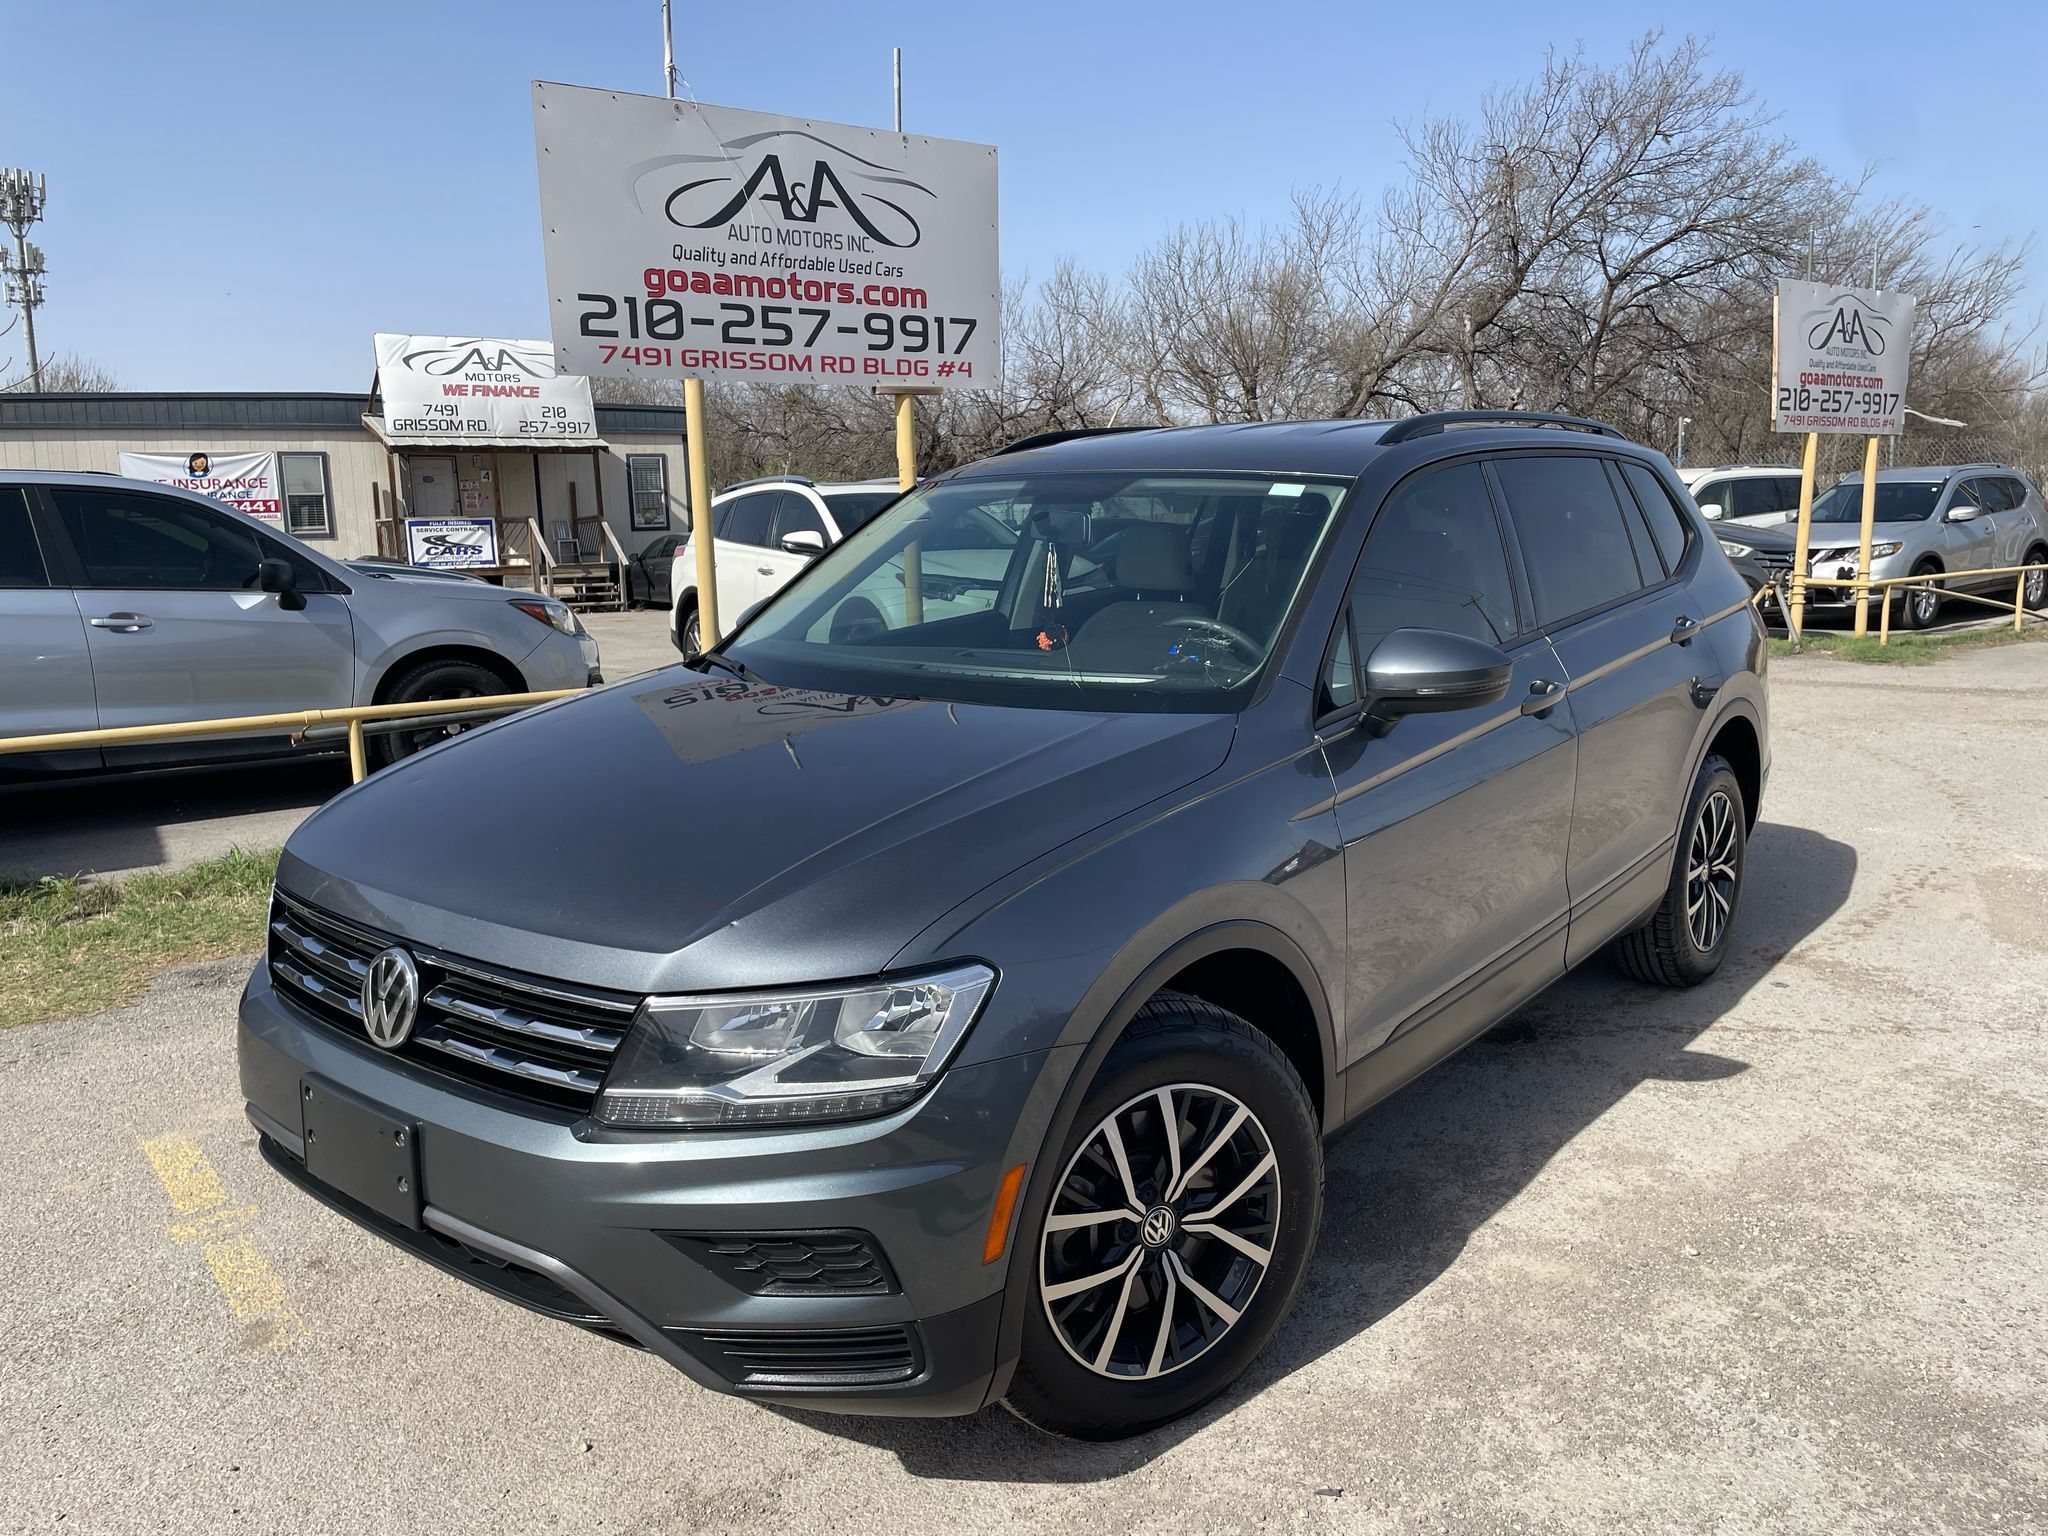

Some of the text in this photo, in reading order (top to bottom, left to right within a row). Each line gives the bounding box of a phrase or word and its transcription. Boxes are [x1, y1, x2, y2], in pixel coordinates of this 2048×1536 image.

[728, 223, 874, 253] AUTO MOTORS INC.
[672, 244, 903, 278] Quality and Affordable Used Cars
[644, 267, 928, 309] goaamotors.com
[577, 293, 977, 355] 210-257-9917
[599, 345, 973, 378] 7491 GRISSOM RD BLDG #4
[465, 373, 521, 383] MOTORS
[1800, 371, 1883, 390] goaamotors.com
[442, 384, 540, 398] WE FINANCE
[1779, 388, 1899, 415] 210-257-9917
[422, 404, 459, 417] 7491
[541, 406, 567, 418] 210
[393, 419, 490, 432] GRISSOM RD.
[519, 421, 590, 434] 257-9917
[1784, 415, 1806, 426] 7491
[1807, 416, 1846, 428] GRISSOM
[1848, 417, 1858, 428] RD
[1861, 417, 1881, 428] BLDG
[483, 471, 490, 481] 4
[173, 478, 268, 490] INSURANCE
[425, 545, 483, 556] CARS
